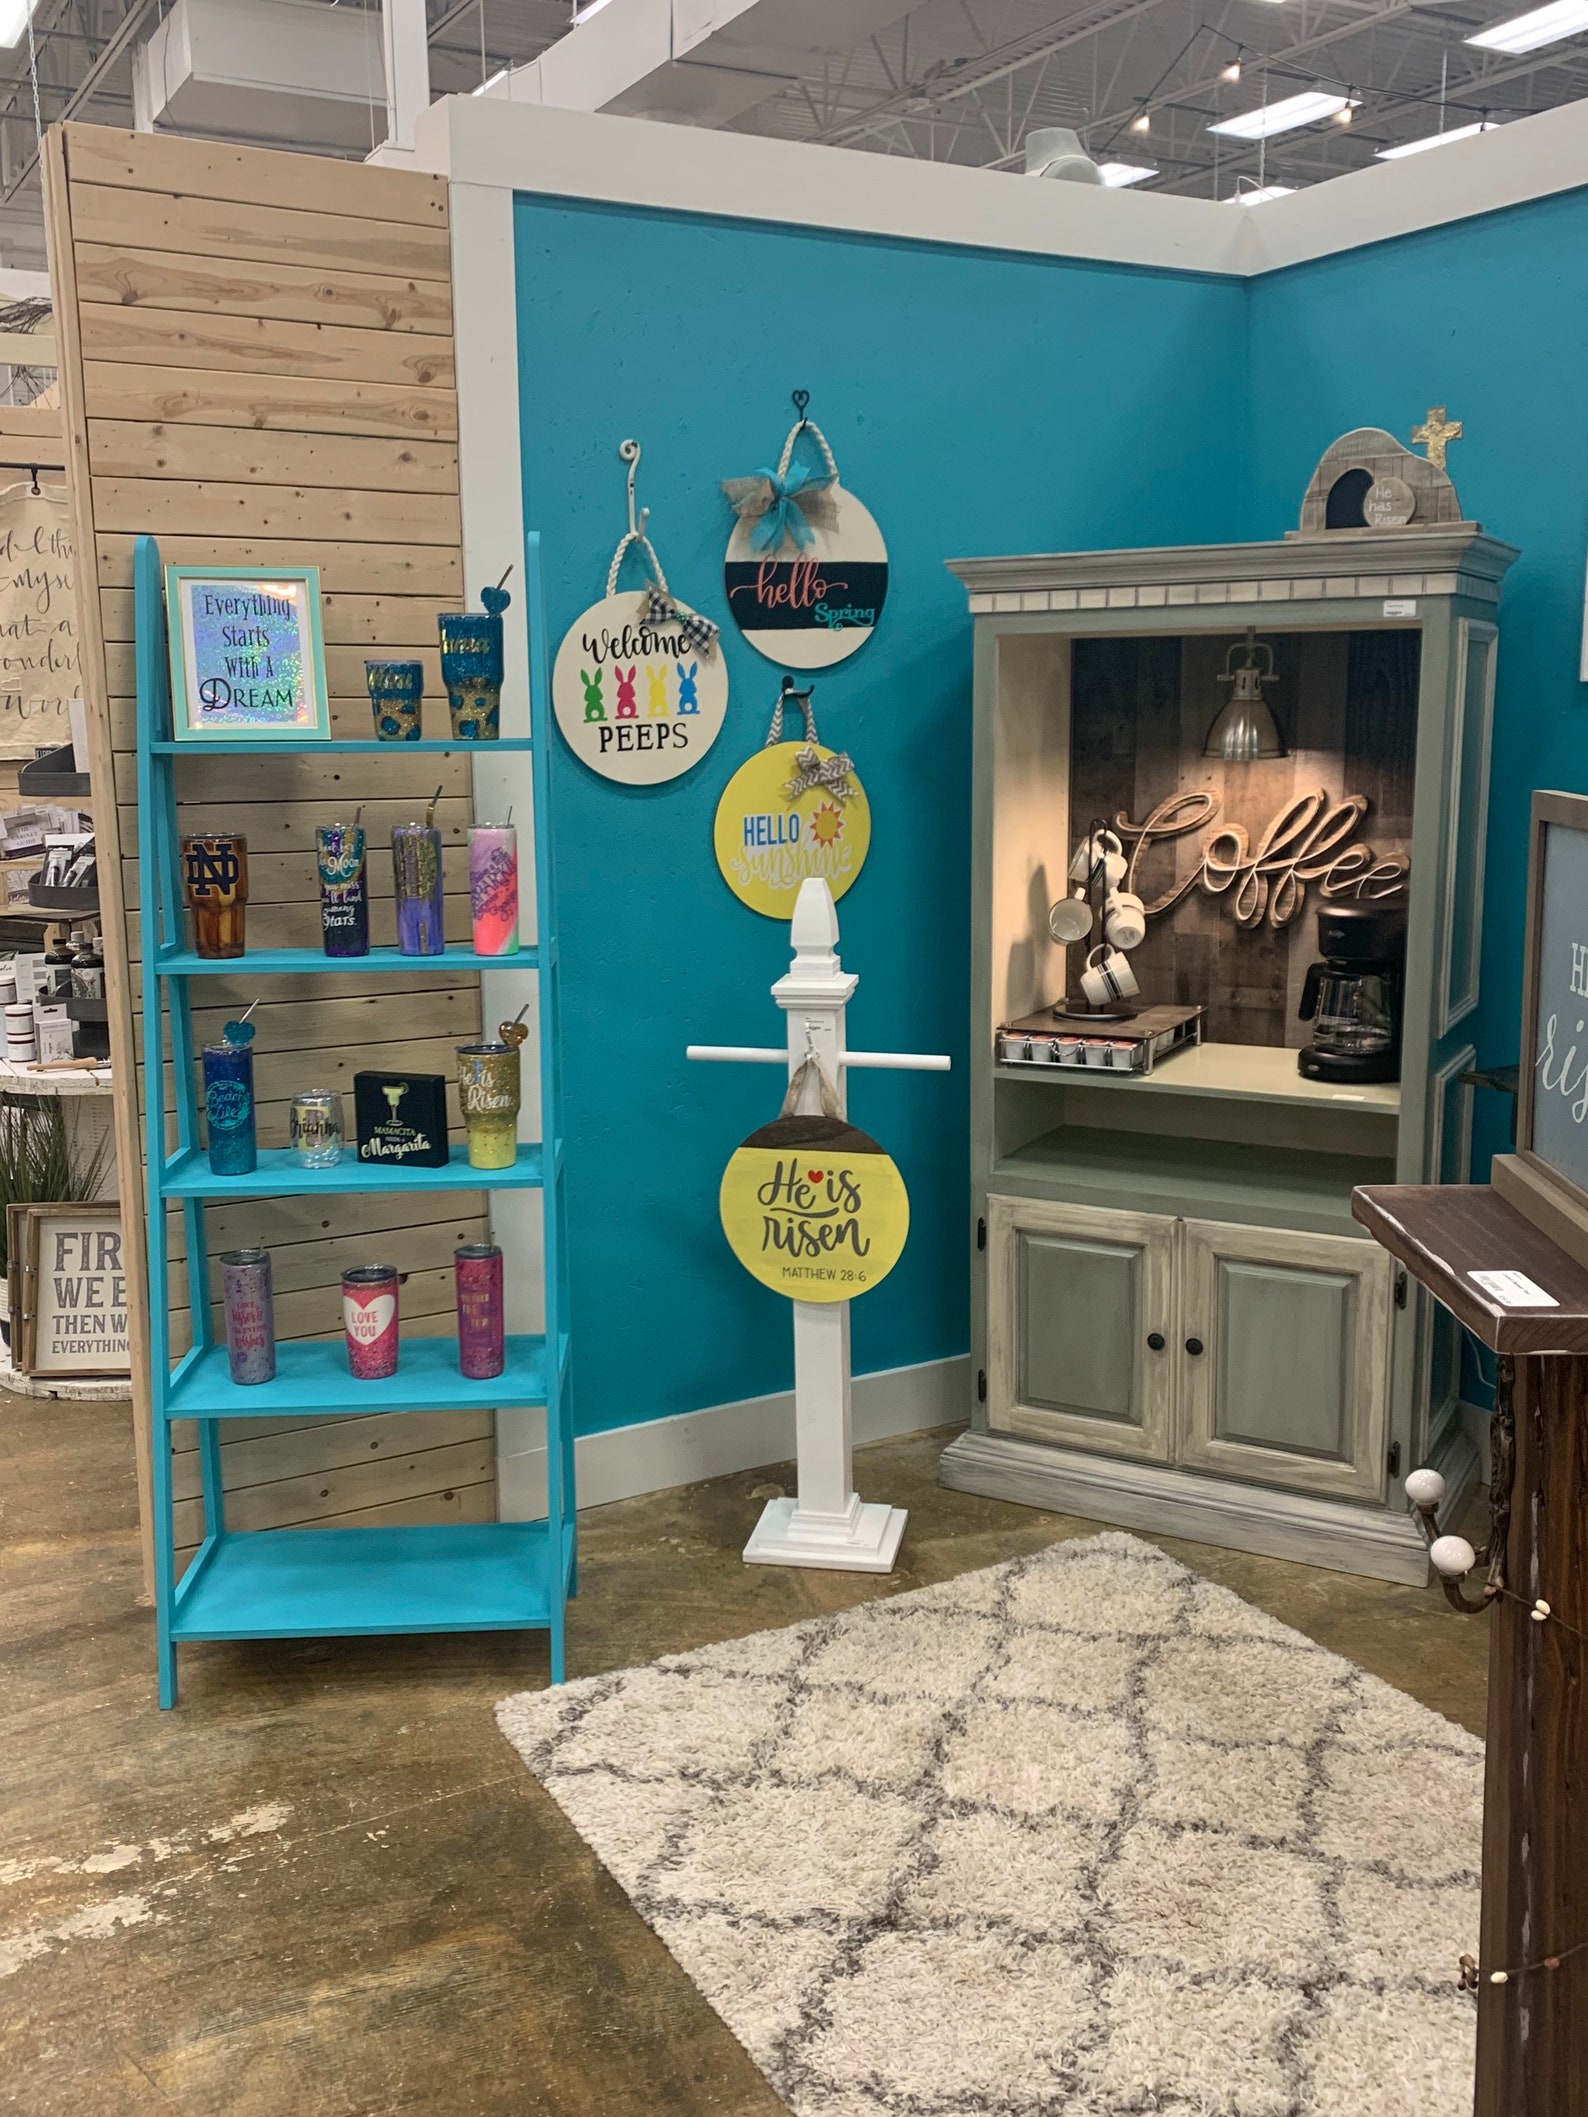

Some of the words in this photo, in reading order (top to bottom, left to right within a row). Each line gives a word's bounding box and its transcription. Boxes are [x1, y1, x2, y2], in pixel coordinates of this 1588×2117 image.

[1368, 500, 1392, 512] has
[1375, 487, 1393, 500] He
[1373, 514, 1408, 526] Risen
[12, 568, 74, 614] myse
[730, 553, 848, 609] hello
[203, 594, 291, 622] Everything
[814, 602, 876, 631] Spring
[222, 625, 271, 648] Starts
[582, 624, 693, 664] Welcome
[225, 656, 259, 679] With
[265, 656, 275, 679] A
[598, 722, 689, 753] PEEPS
[743, 813, 800, 847] HELLO
[1112, 786, 1411, 929] Coffee
[467, 1085, 512, 1111] Risen
[361, 1132, 432, 1160] Margarita
[757, 1158, 817, 1210] He
[826, 1169, 862, 1214] is
[761, 1215, 871, 1258] risen
[54, 1231, 123, 1271] FIR
[782, 1266, 836, 1281] MATTHEW
[840, 1269, 867, 1282] 28:6
[53, 1276, 104, 1309] WE
[52, 1314, 106, 1335] THEN
[351, 1310, 379, 1325] LOVE
[354, 1325, 377, 1338] YOU
